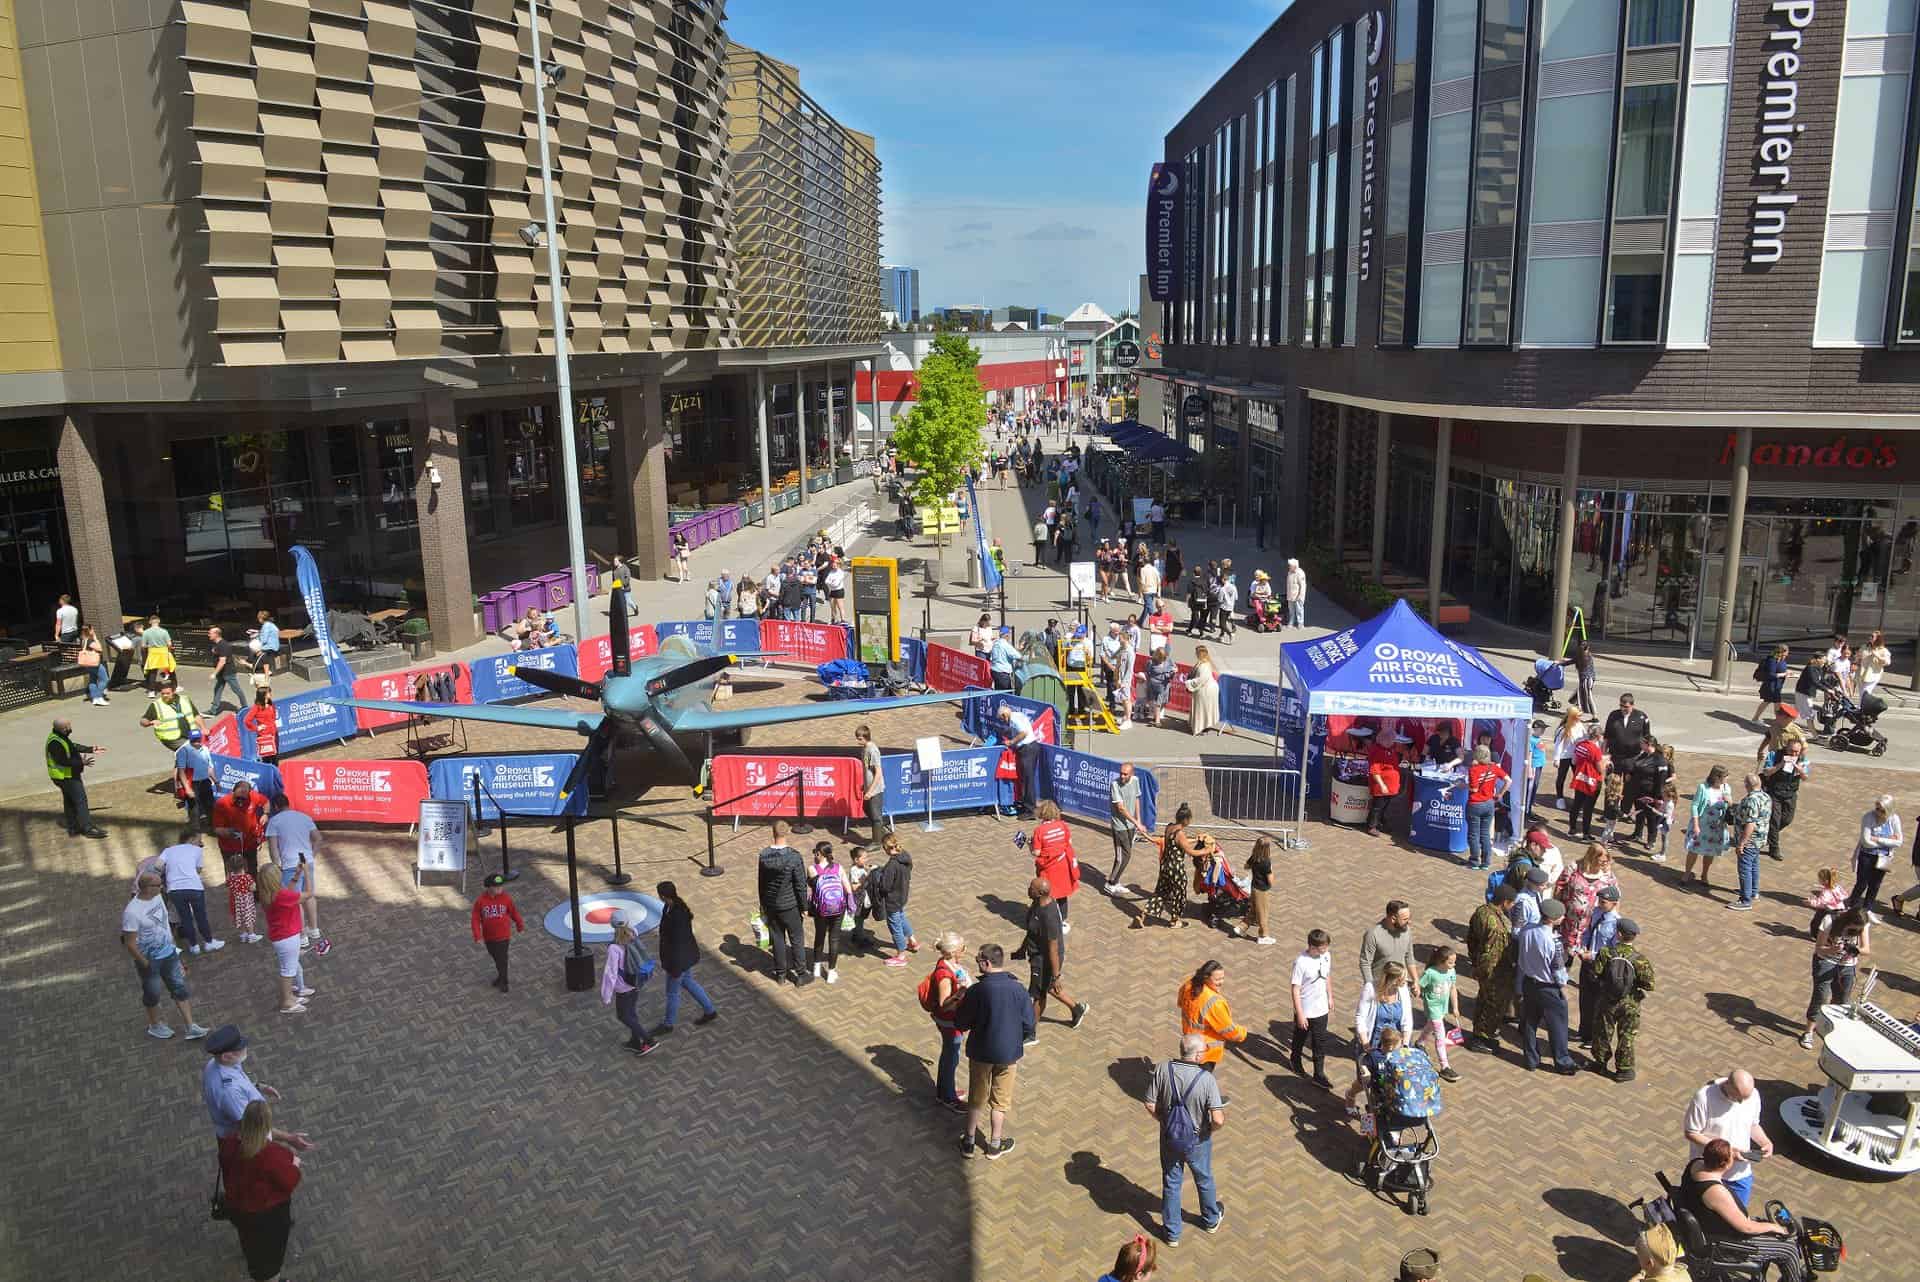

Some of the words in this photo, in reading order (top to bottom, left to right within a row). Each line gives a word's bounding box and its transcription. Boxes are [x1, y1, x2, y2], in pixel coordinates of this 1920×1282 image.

[1760, 0, 1815, 185] Premier
[1363, 75, 1379, 220] Premier
[1158, 200, 1174, 265] Premier
[1751, 194, 1798, 262] Inn
[1360, 228, 1373, 281] Inn
[1157, 270, 1173, 295] Inn
[671, 392, 701, 413] Zizzi
[29, 469, 39, 480] &
[1400, 648, 1457, 666] ROYAL
[1369, 661, 1400, 672] AIR
[1402, 661, 1461, 677] FORCE
[1369, 673, 1464, 687] museum
[347, 770, 370, 778] ROYAL
[494, 774, 506, 782] AIR
[944, 766, 968, 774] FORCE
[491, 781, 534, 789] museum
[1440, 803, 1463, 811] ROYAL
[1440, 810, 1463, 818] FORCE
